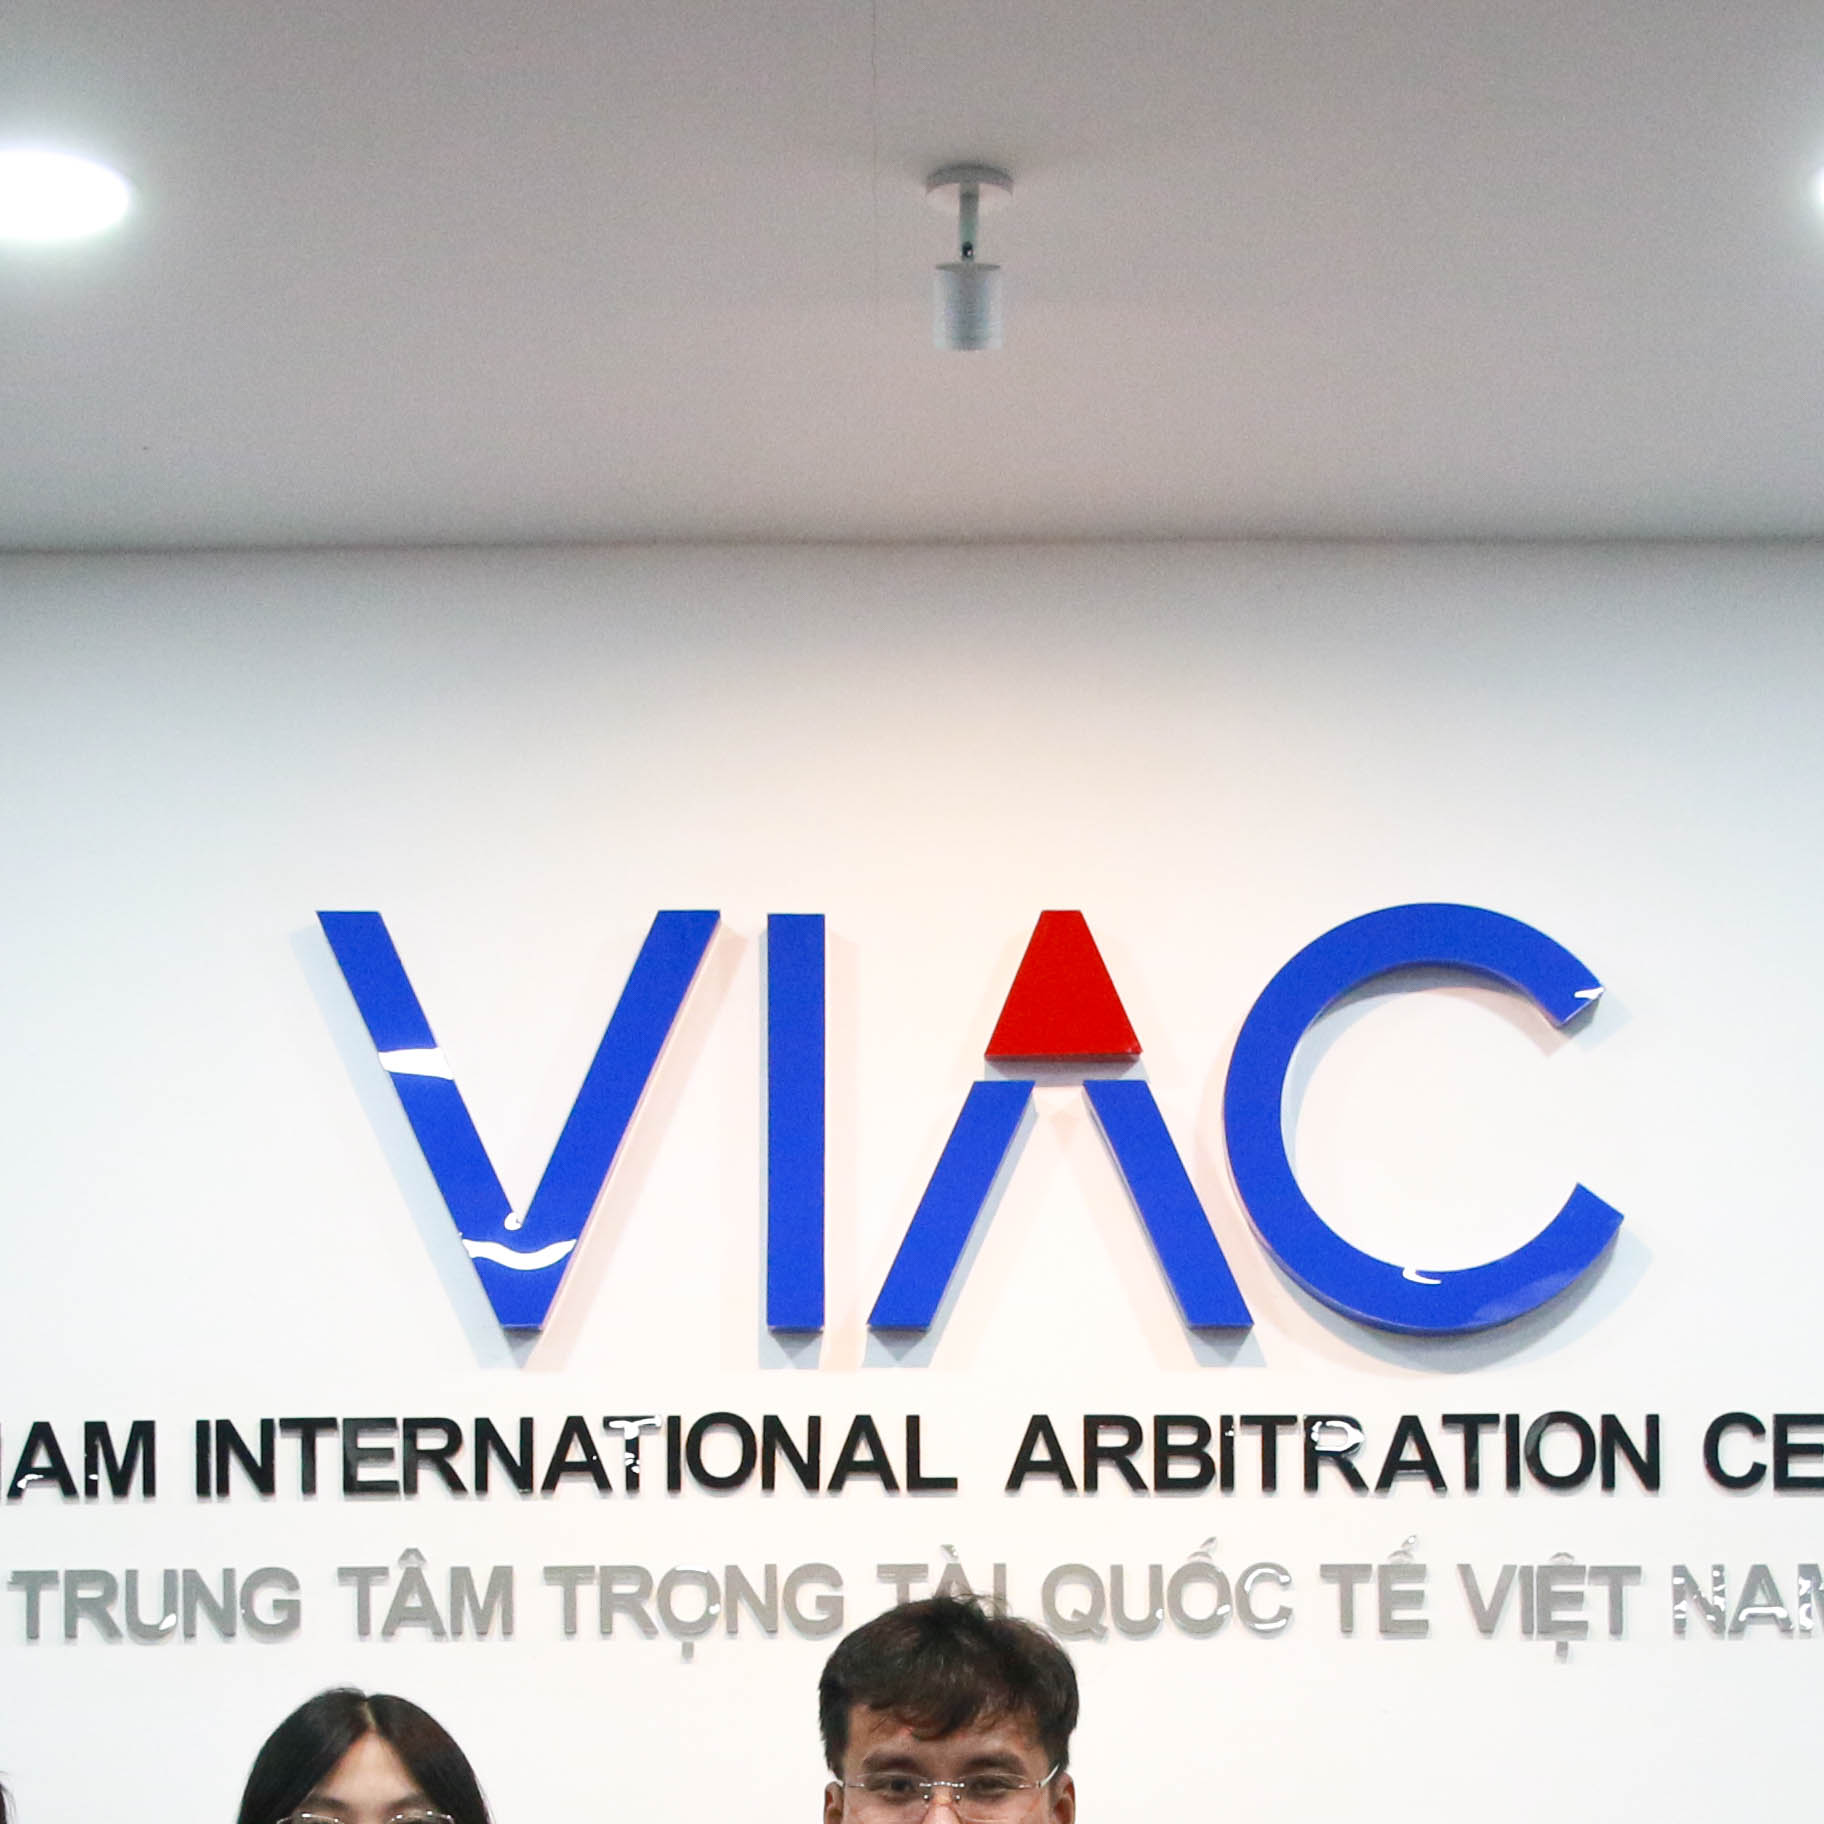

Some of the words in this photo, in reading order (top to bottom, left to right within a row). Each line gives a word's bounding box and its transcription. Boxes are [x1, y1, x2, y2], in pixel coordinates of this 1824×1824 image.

[316, 903, 1625, 1333] VIAC
[195, 1412, 958, 1498] INTERNATIONAL
[1005, 1412, 1660, 1492] ARBITRATION
[8, 1566, 301, 1641] TRUNG
[337, 1547, 514, 1637] TÂM
[544, 1562, 844, 1658] TRỌNG
[1041, 1537, 1294, 1638] QUỐC
[1320, 1535, 1430, 1635] TẾ
[1456, 1552, 1642, 1657] VIỆT
